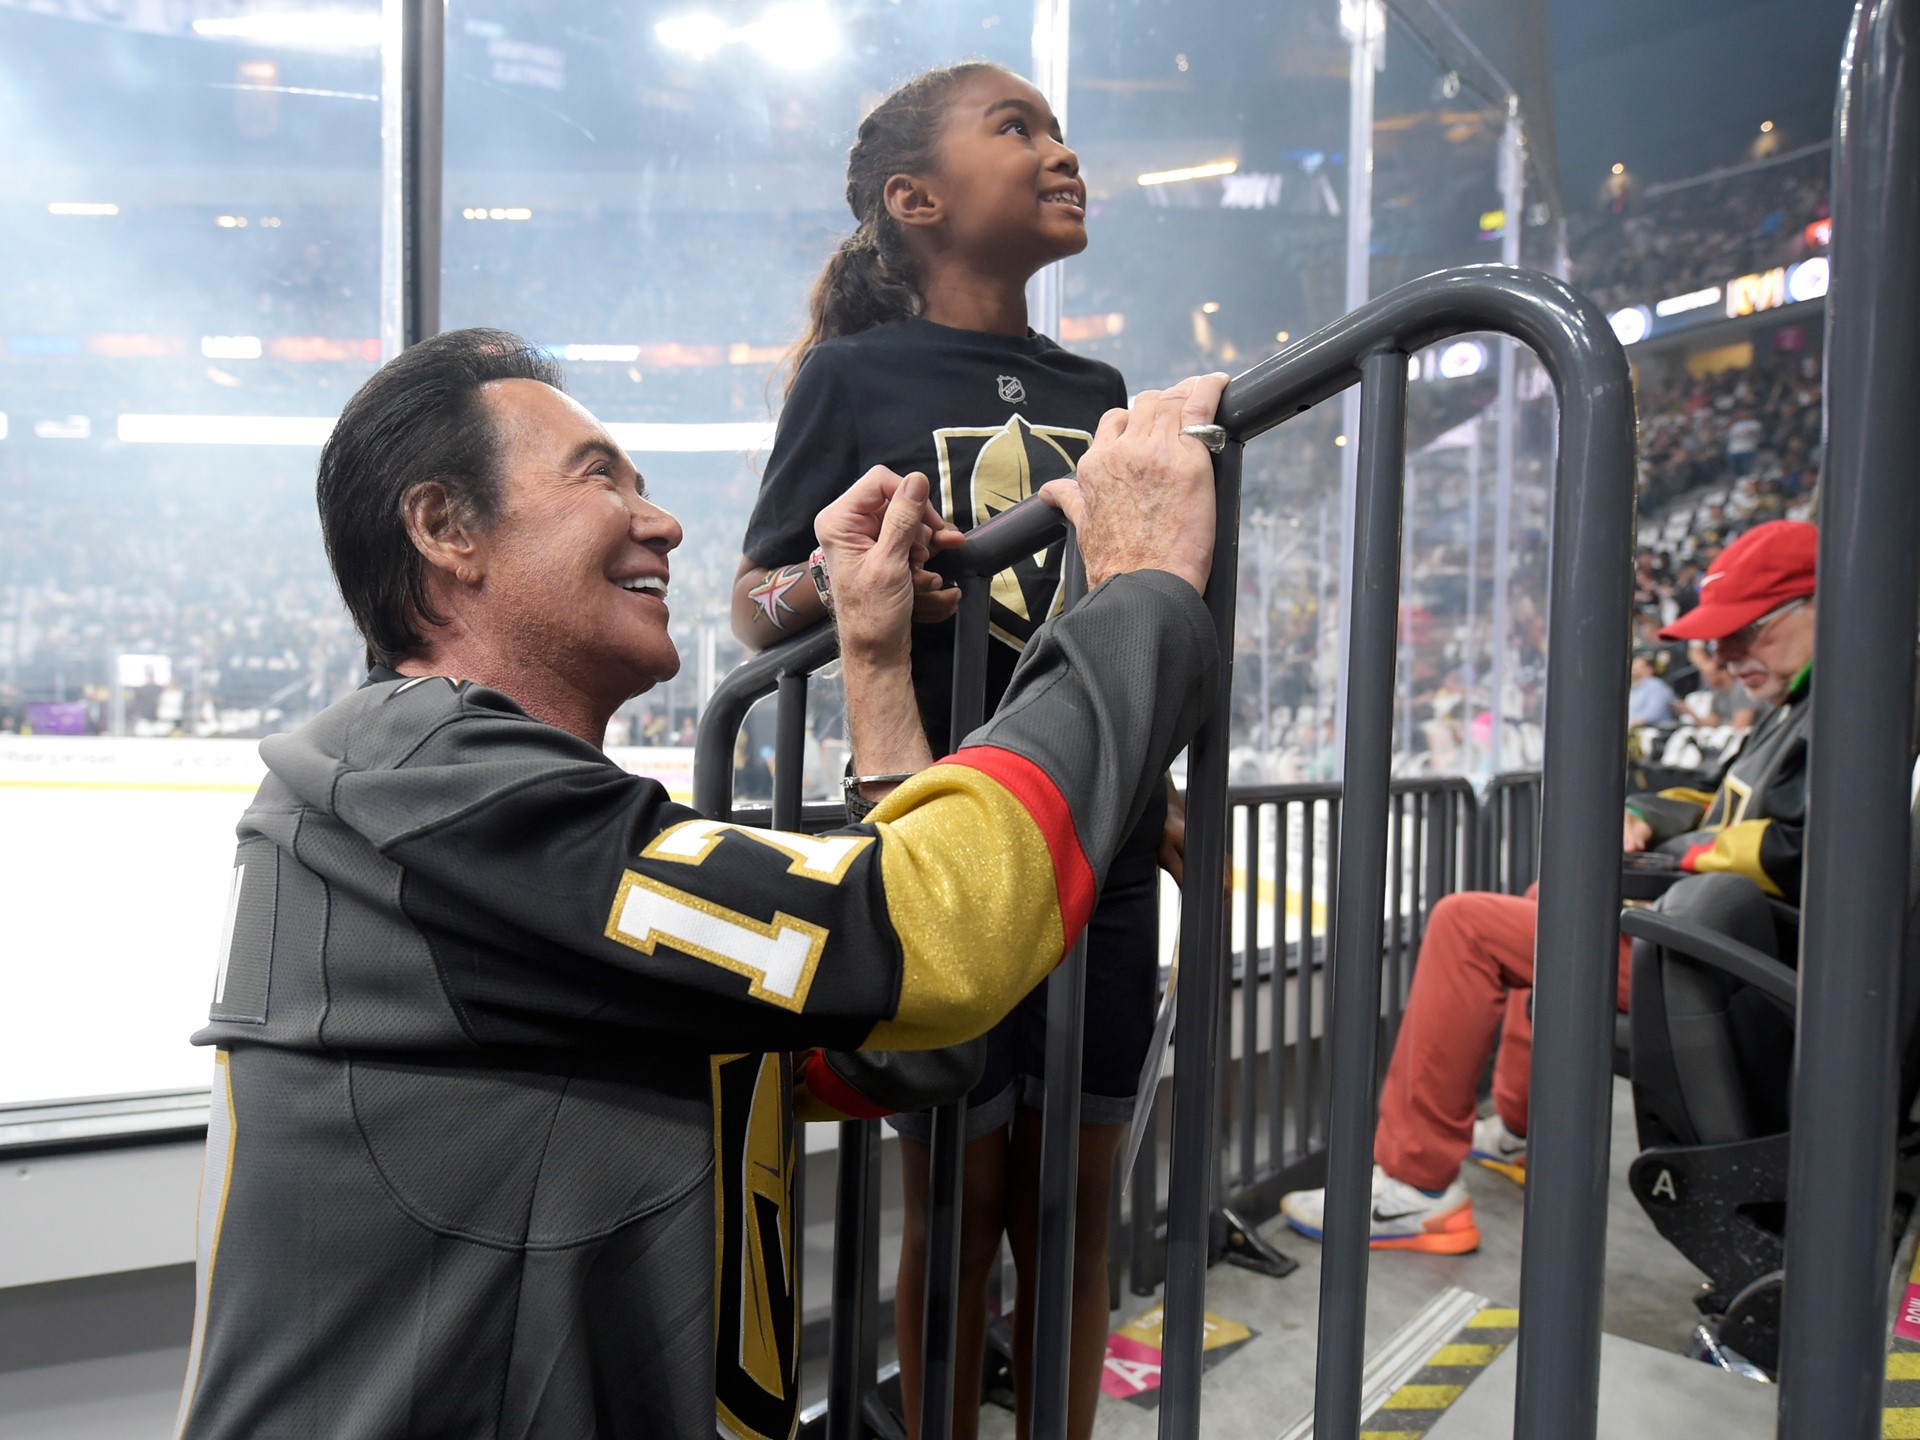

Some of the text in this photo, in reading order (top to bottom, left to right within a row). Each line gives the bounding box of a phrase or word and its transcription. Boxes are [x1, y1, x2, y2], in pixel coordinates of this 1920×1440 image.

[604, 819, 876, 1014] 17
[1652, 1169, 1677, 1201] A
[1104, 1357, 1162, 1391] A
